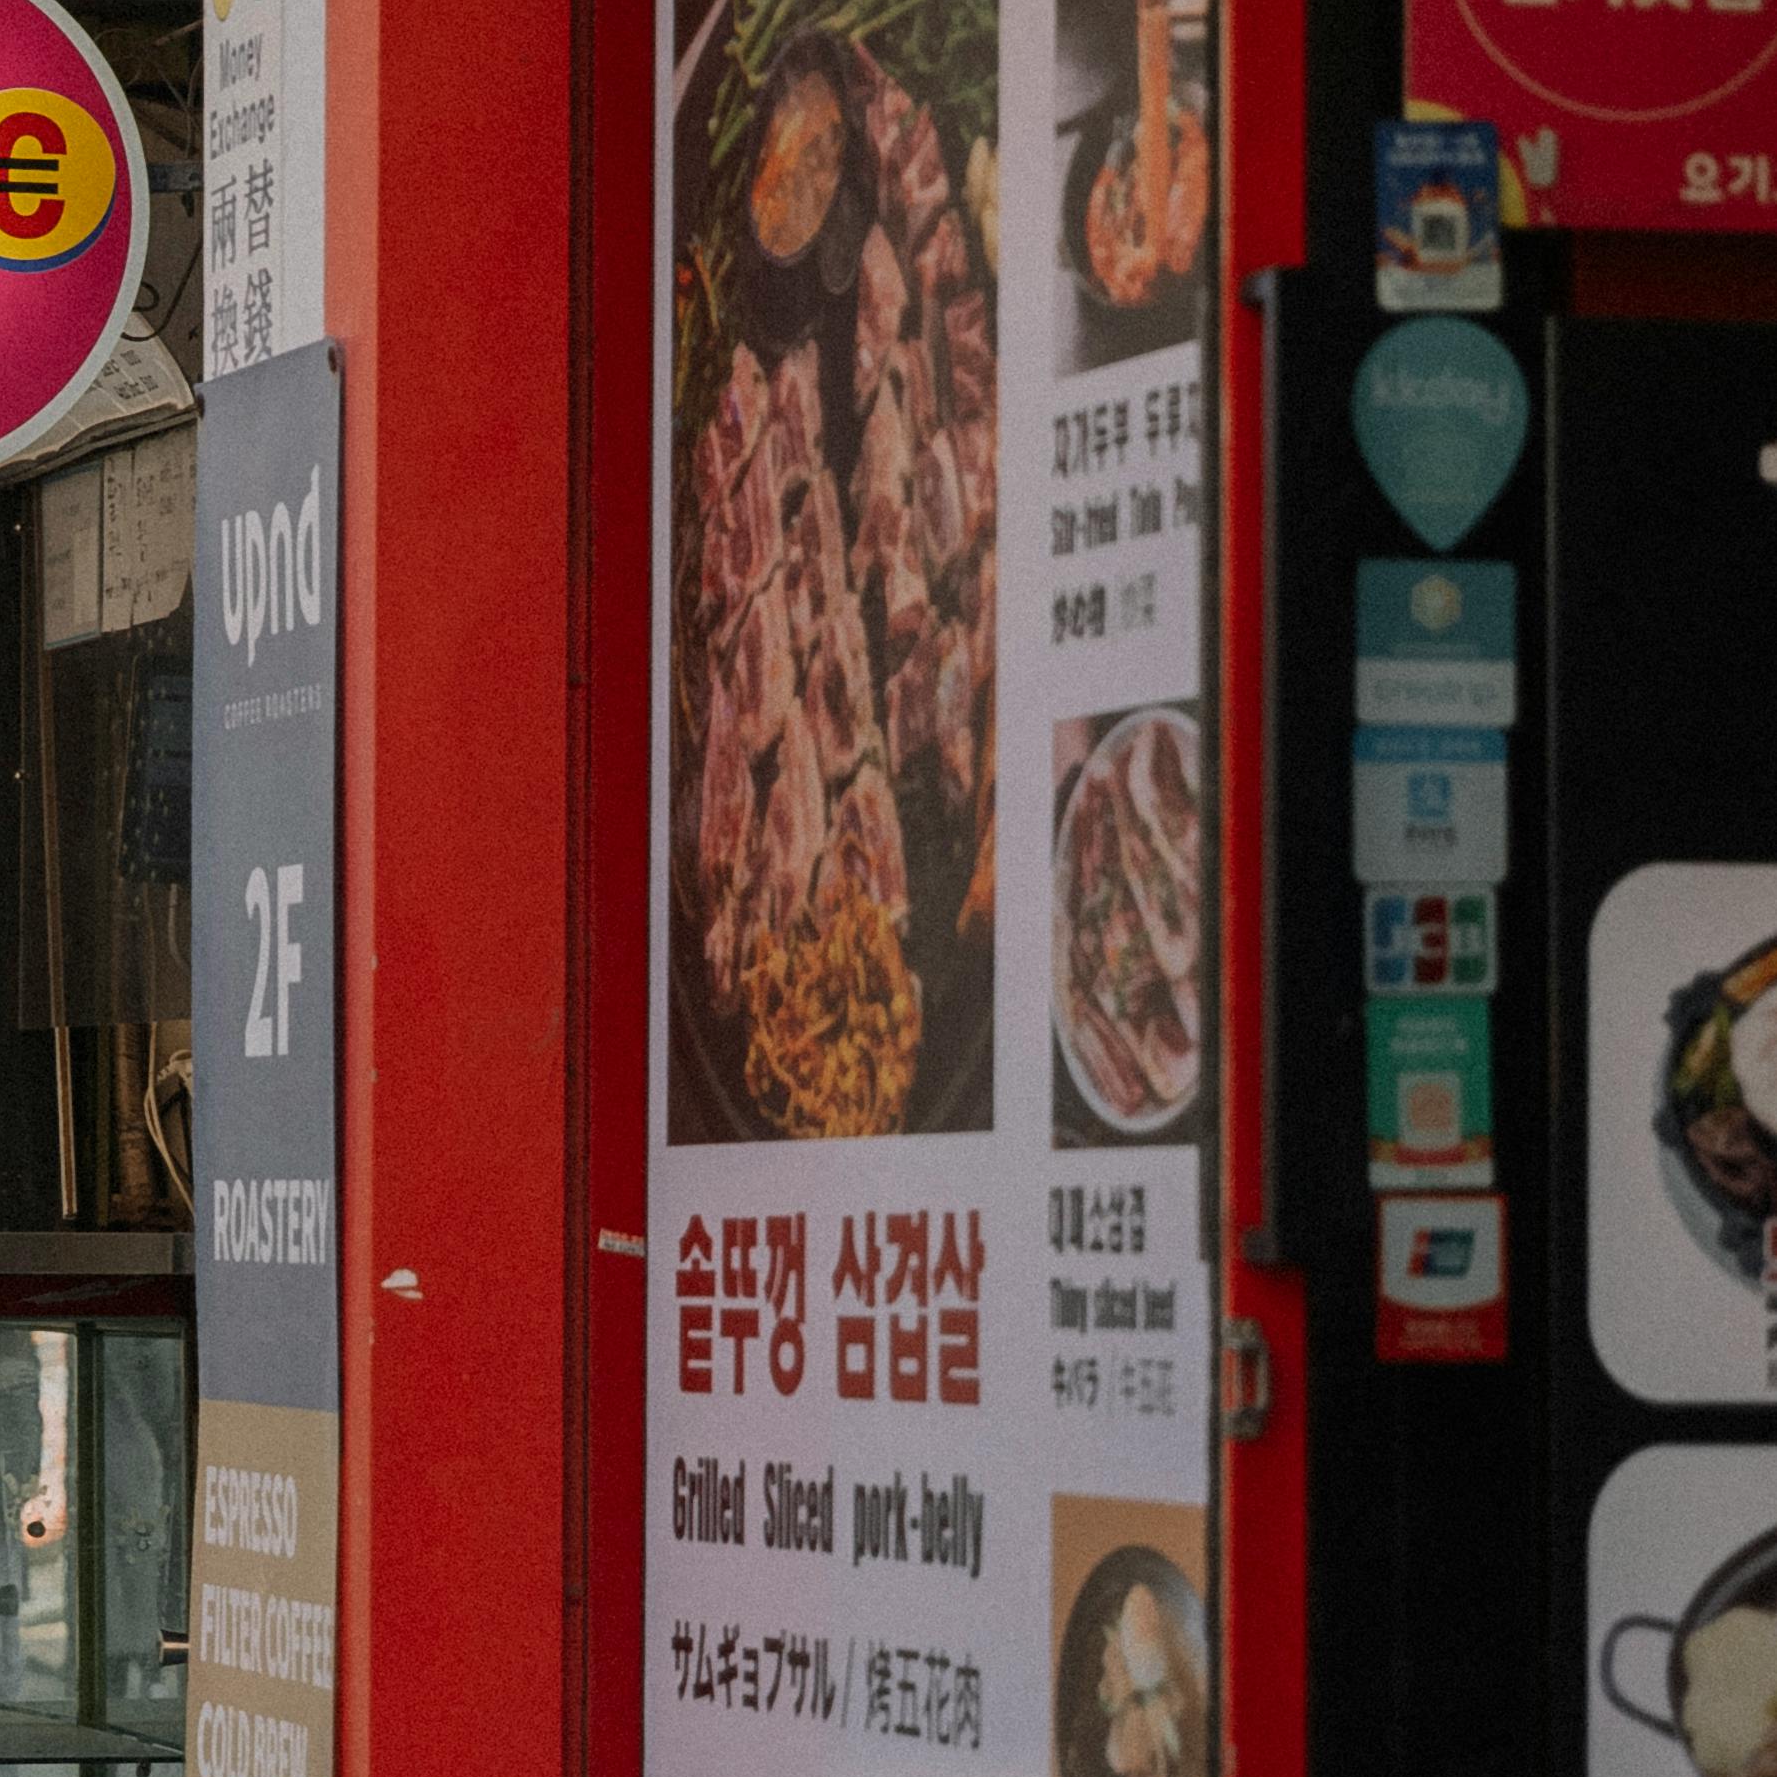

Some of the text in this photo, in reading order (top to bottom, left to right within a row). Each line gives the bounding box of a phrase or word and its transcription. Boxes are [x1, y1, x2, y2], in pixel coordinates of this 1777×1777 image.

[219, 31, 263, 92] Money
[209, 93, 276, 162] Exchange
[1678, 149, 1777, 208] 요기
[243, 863, 306, 1059] 2F
[212, 1176, 330, 1266] ROASTERY
[674, 1209, 986, 1406] 솥뚜껑 삼겹살
[204, 1465, 298, 1559] ESPRESSO
[672, 1454, 746, 1547] Grilled
[762, 1461, 834, 1556] Sliced
[200, 1582, 333, 1689] FILTER COFFEE
